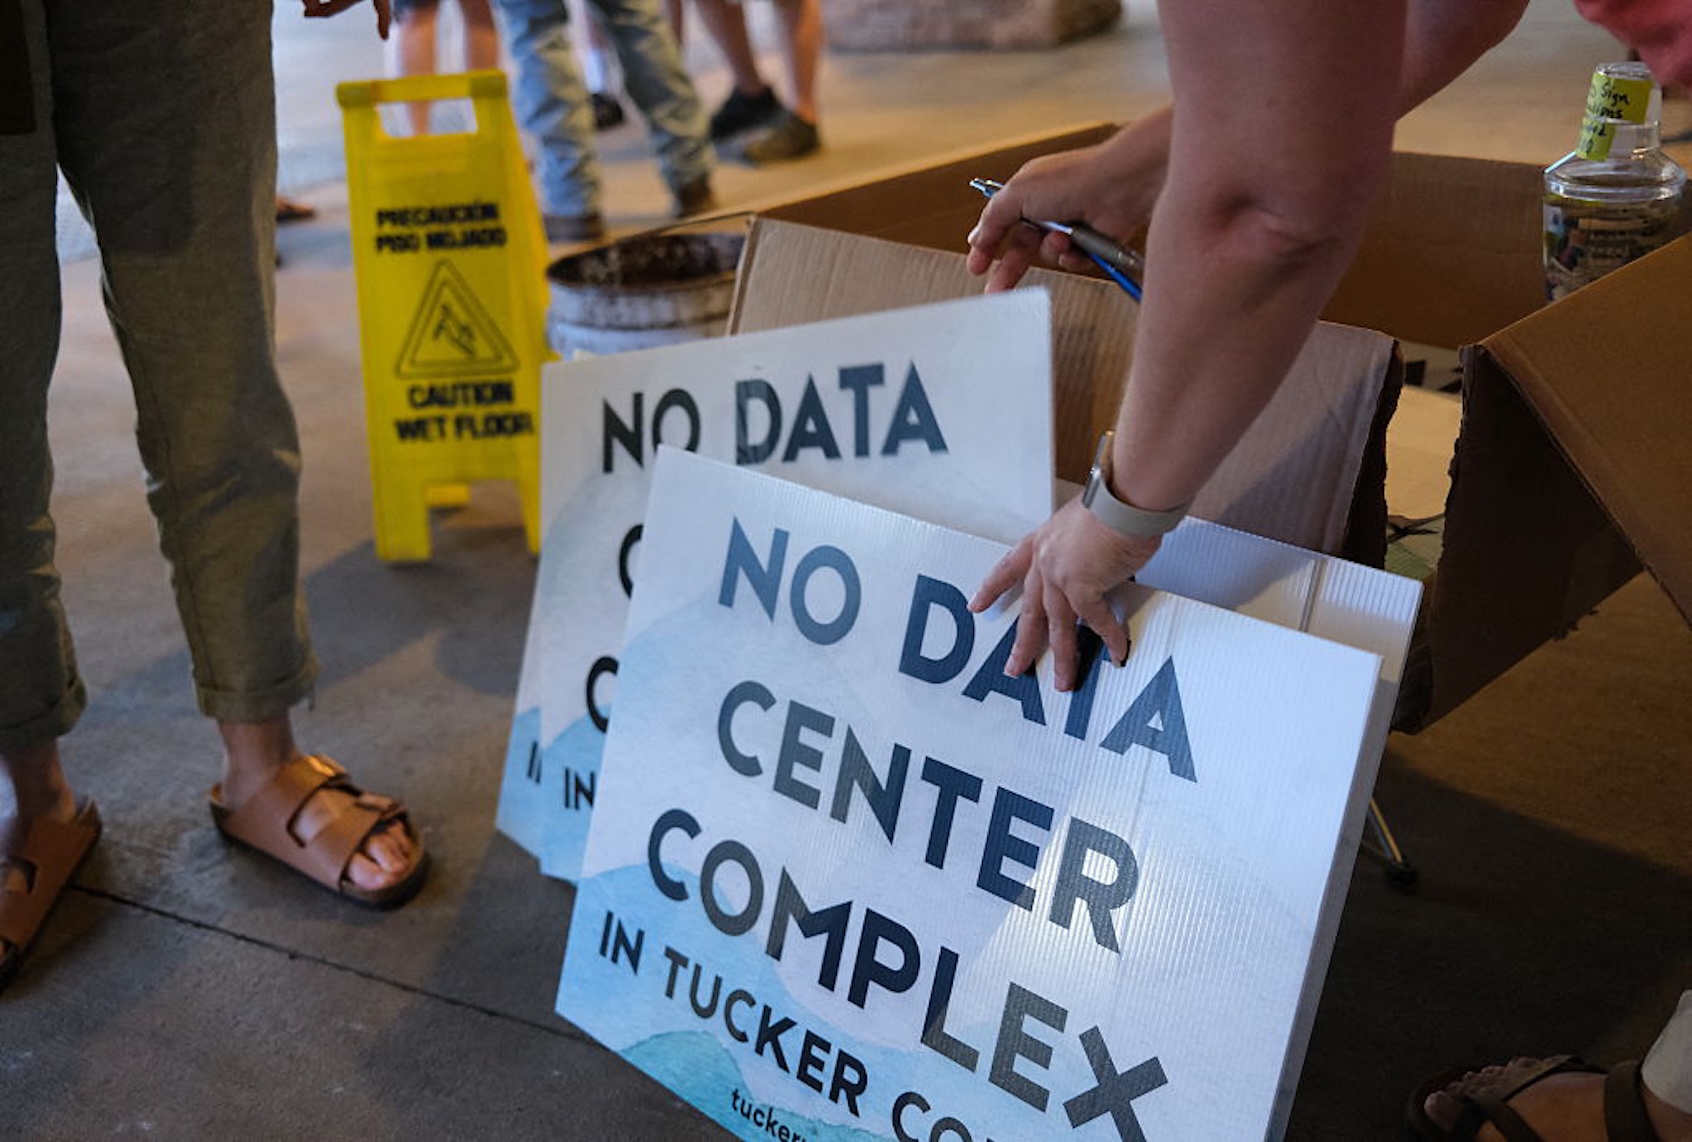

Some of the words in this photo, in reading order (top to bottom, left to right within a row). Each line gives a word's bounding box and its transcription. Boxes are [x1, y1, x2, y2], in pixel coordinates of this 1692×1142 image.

[376, 234, 420, 254] PISO
[426, 227, 508, 251] MOJADO
[395, 416, 446, 442] WET
[455, 411, 534, 440] FLOOR
[408, 381, 514, 409] CAUTION
[603, 388, 701, 474] NO
[735, 361, 949, 465] DATA
[718, 516, 861, 646] NO
[718, 680, 1139, 954] CENTER
[599, 911, 645, 975] IN
[663, 945, 868, 1118] TUCKER
[648, 808, 1169, 1142] COMPLEX
